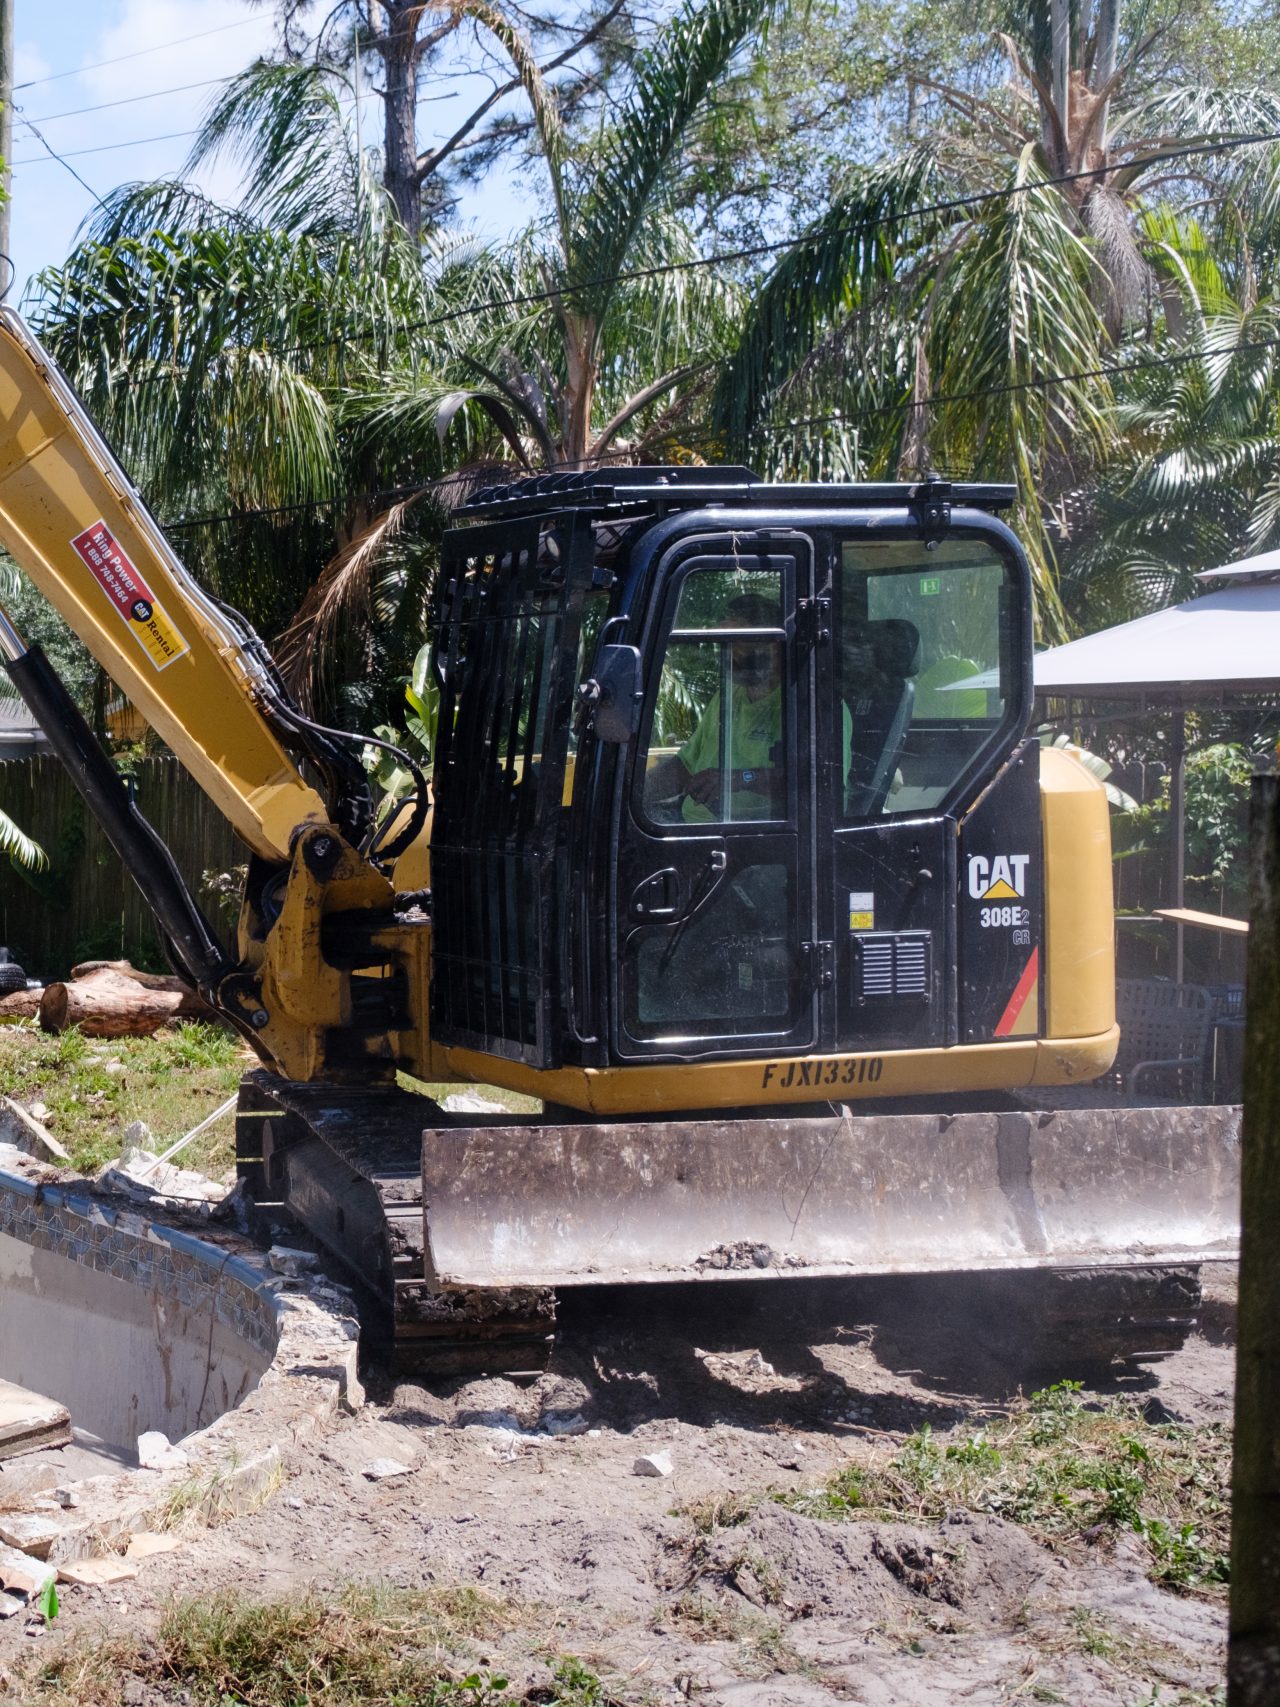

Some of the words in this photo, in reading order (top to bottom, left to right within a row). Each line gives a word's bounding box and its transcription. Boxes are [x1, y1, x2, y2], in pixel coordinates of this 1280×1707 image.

[87, 549, 102, 566] 888
[100, 566, 129, 603] 748-7464
[93, 531, 112, 559] Ring
[110, 557, 137, 592] Power
[134, 602, 150, 619] CAT
[146, 620, 175, 657] Rental
[968, 854, 1030, 899] CAT
[1012, 930, 1030, 945] CR
